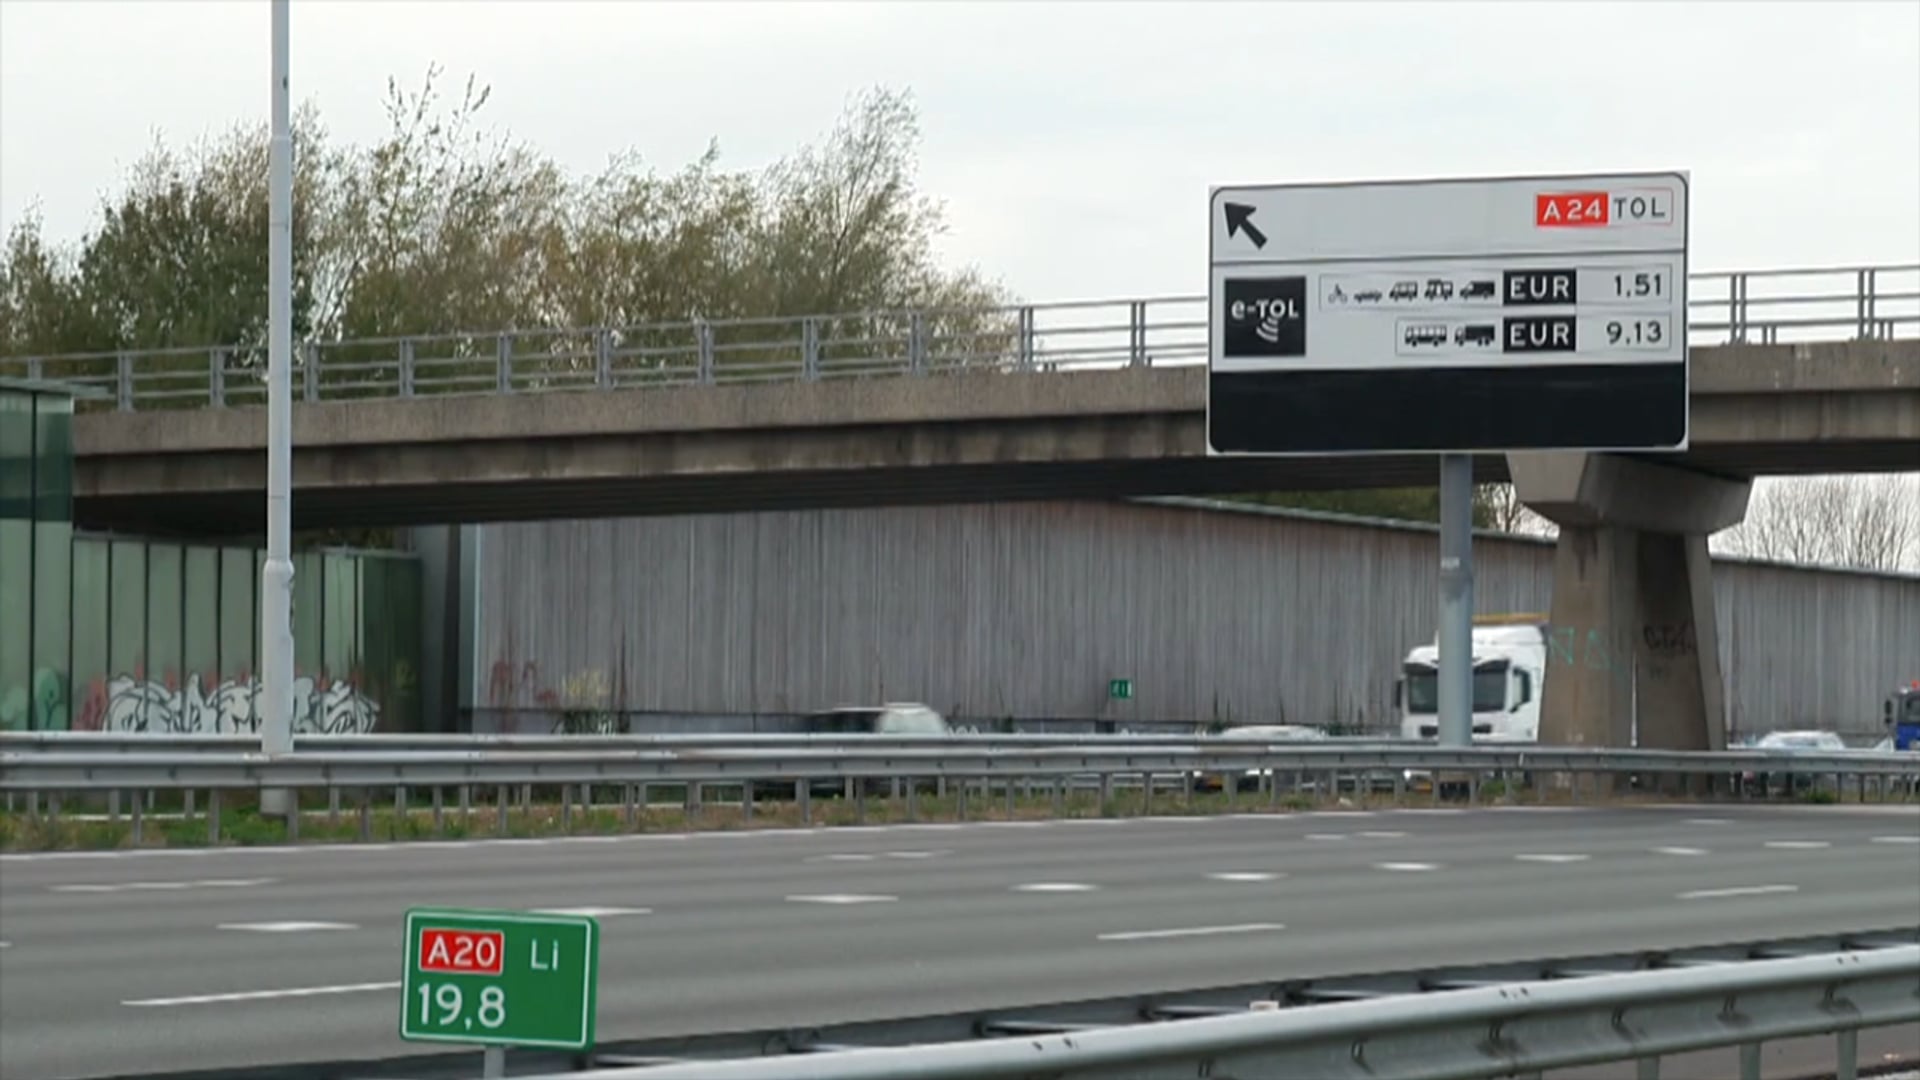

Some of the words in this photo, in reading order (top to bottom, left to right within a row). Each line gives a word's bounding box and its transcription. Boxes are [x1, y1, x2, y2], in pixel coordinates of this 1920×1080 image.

[1542, 197, 1602, 223] A24
[1613, 196, 1666, 220] TOL
[1510, 275, 1570, 299] EUR
[1231, 298, 1300, 320] e-TOL
[1510, 321, 1570, 347] EUR
[427, 934, 497, 968] A20
[530, 938, 559, 971] Li
[418, 982, 506, 1030] 19,8
